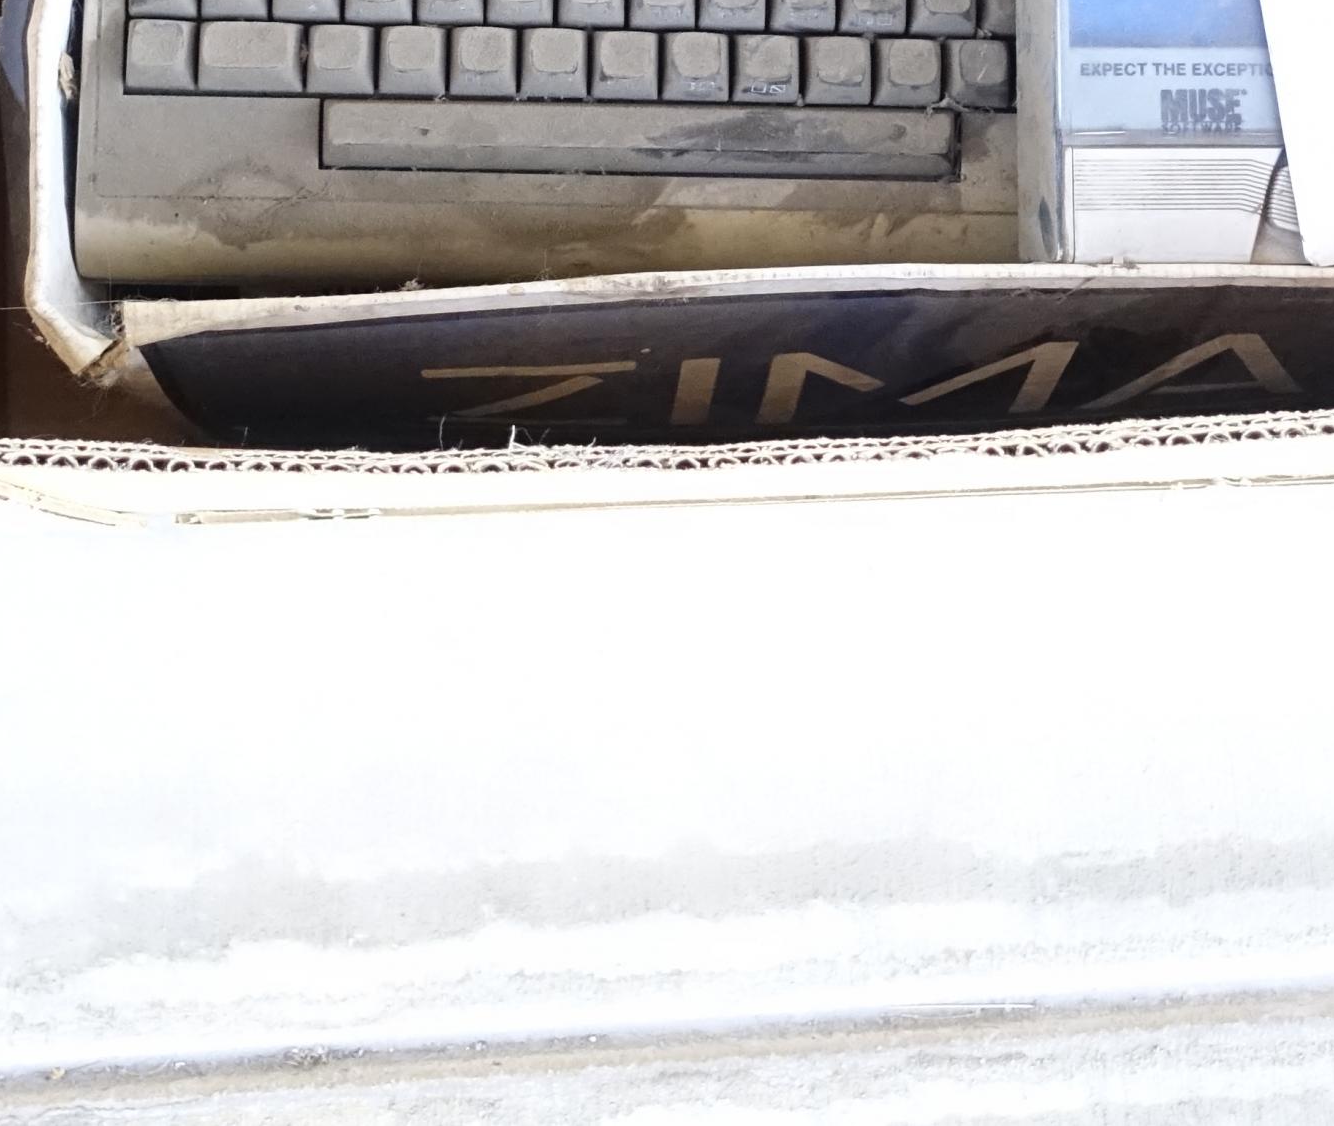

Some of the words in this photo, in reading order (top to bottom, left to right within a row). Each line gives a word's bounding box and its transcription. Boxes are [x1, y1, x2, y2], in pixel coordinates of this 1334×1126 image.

[1080, 62, 1147, 77] EXPECT
[1152, 62, 1187, 77] THE
[421, 333, 1301, 425] ZIMA
